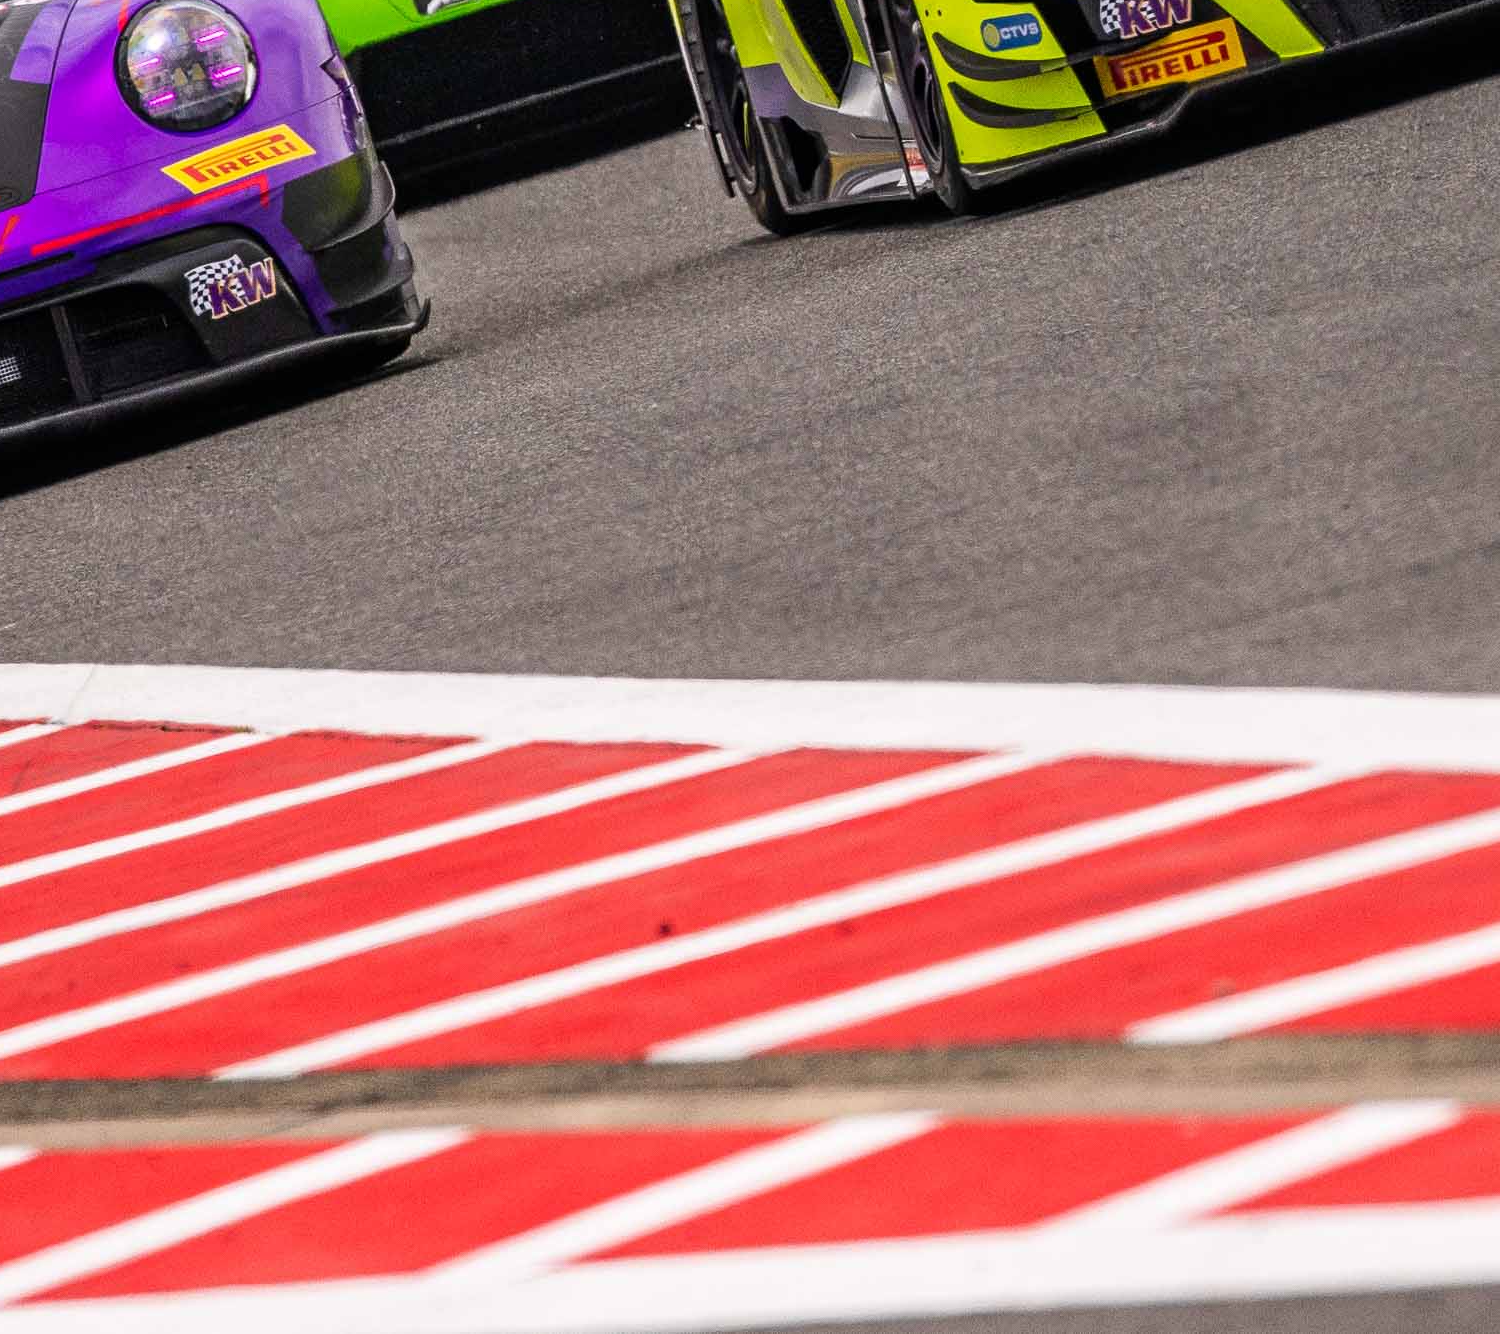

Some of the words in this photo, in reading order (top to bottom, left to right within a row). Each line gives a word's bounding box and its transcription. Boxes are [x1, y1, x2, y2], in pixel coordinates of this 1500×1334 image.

[1000, 21, 1039, 40] CTVS
[1108, 31, 1231, 92] PIRELLI
[182, 133, 298, 183] PIRELLI
[209, 257, 275, 319] KW
